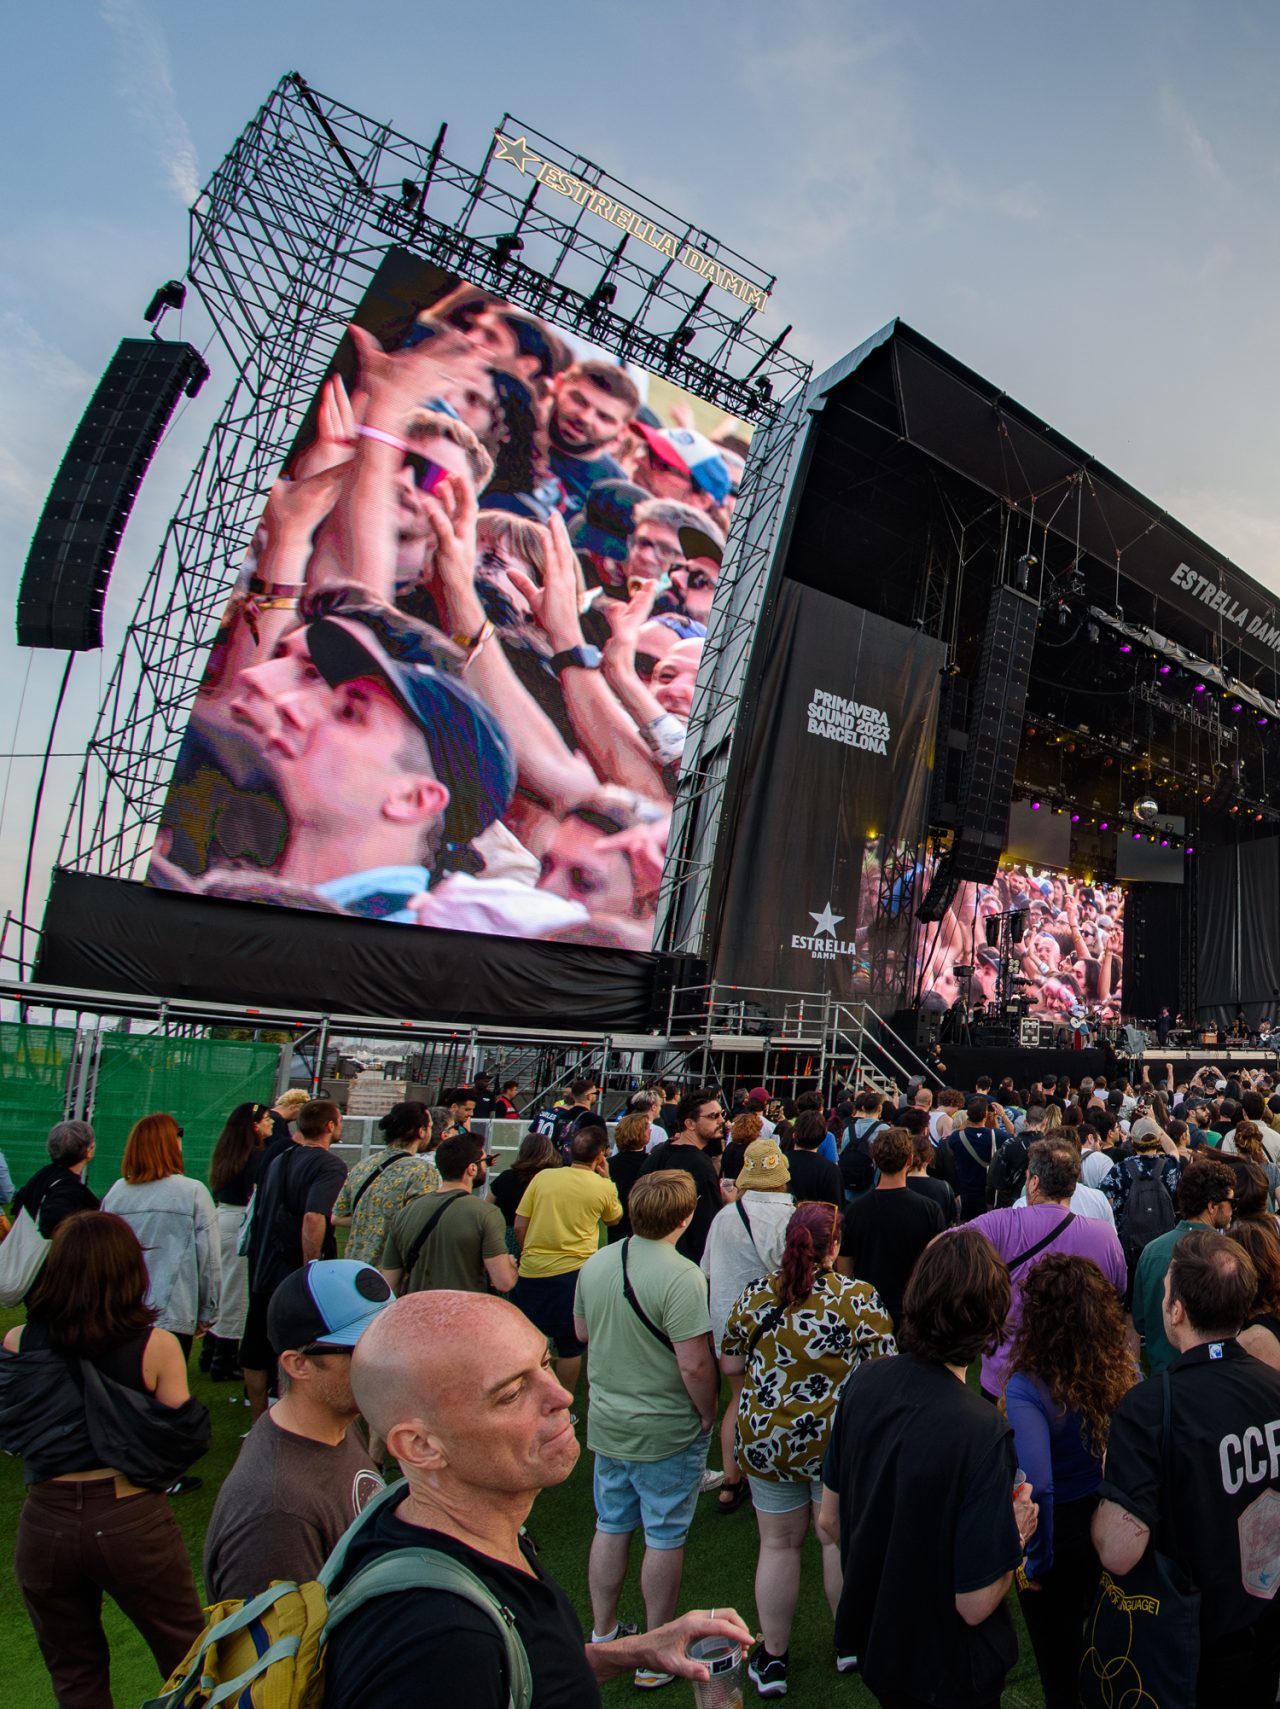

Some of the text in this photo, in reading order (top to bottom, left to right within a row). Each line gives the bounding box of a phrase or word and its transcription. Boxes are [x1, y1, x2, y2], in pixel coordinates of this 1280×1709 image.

[535, 162, 769, 313] ESTRELLA DAMM
[1170, 562, 1249, 627] ESTRELLA
[807, 702, 891, 741] SOUND 2023
[813, 688, 889, 727] PRIMAVERA
[807, 718, 888, 756] BARCELONA
[791, 934, 857, 956] ESTRELLA
[811, 951, 836, 960] DAMM
[1117, 1598, 1156, 1615] NGUAGE
